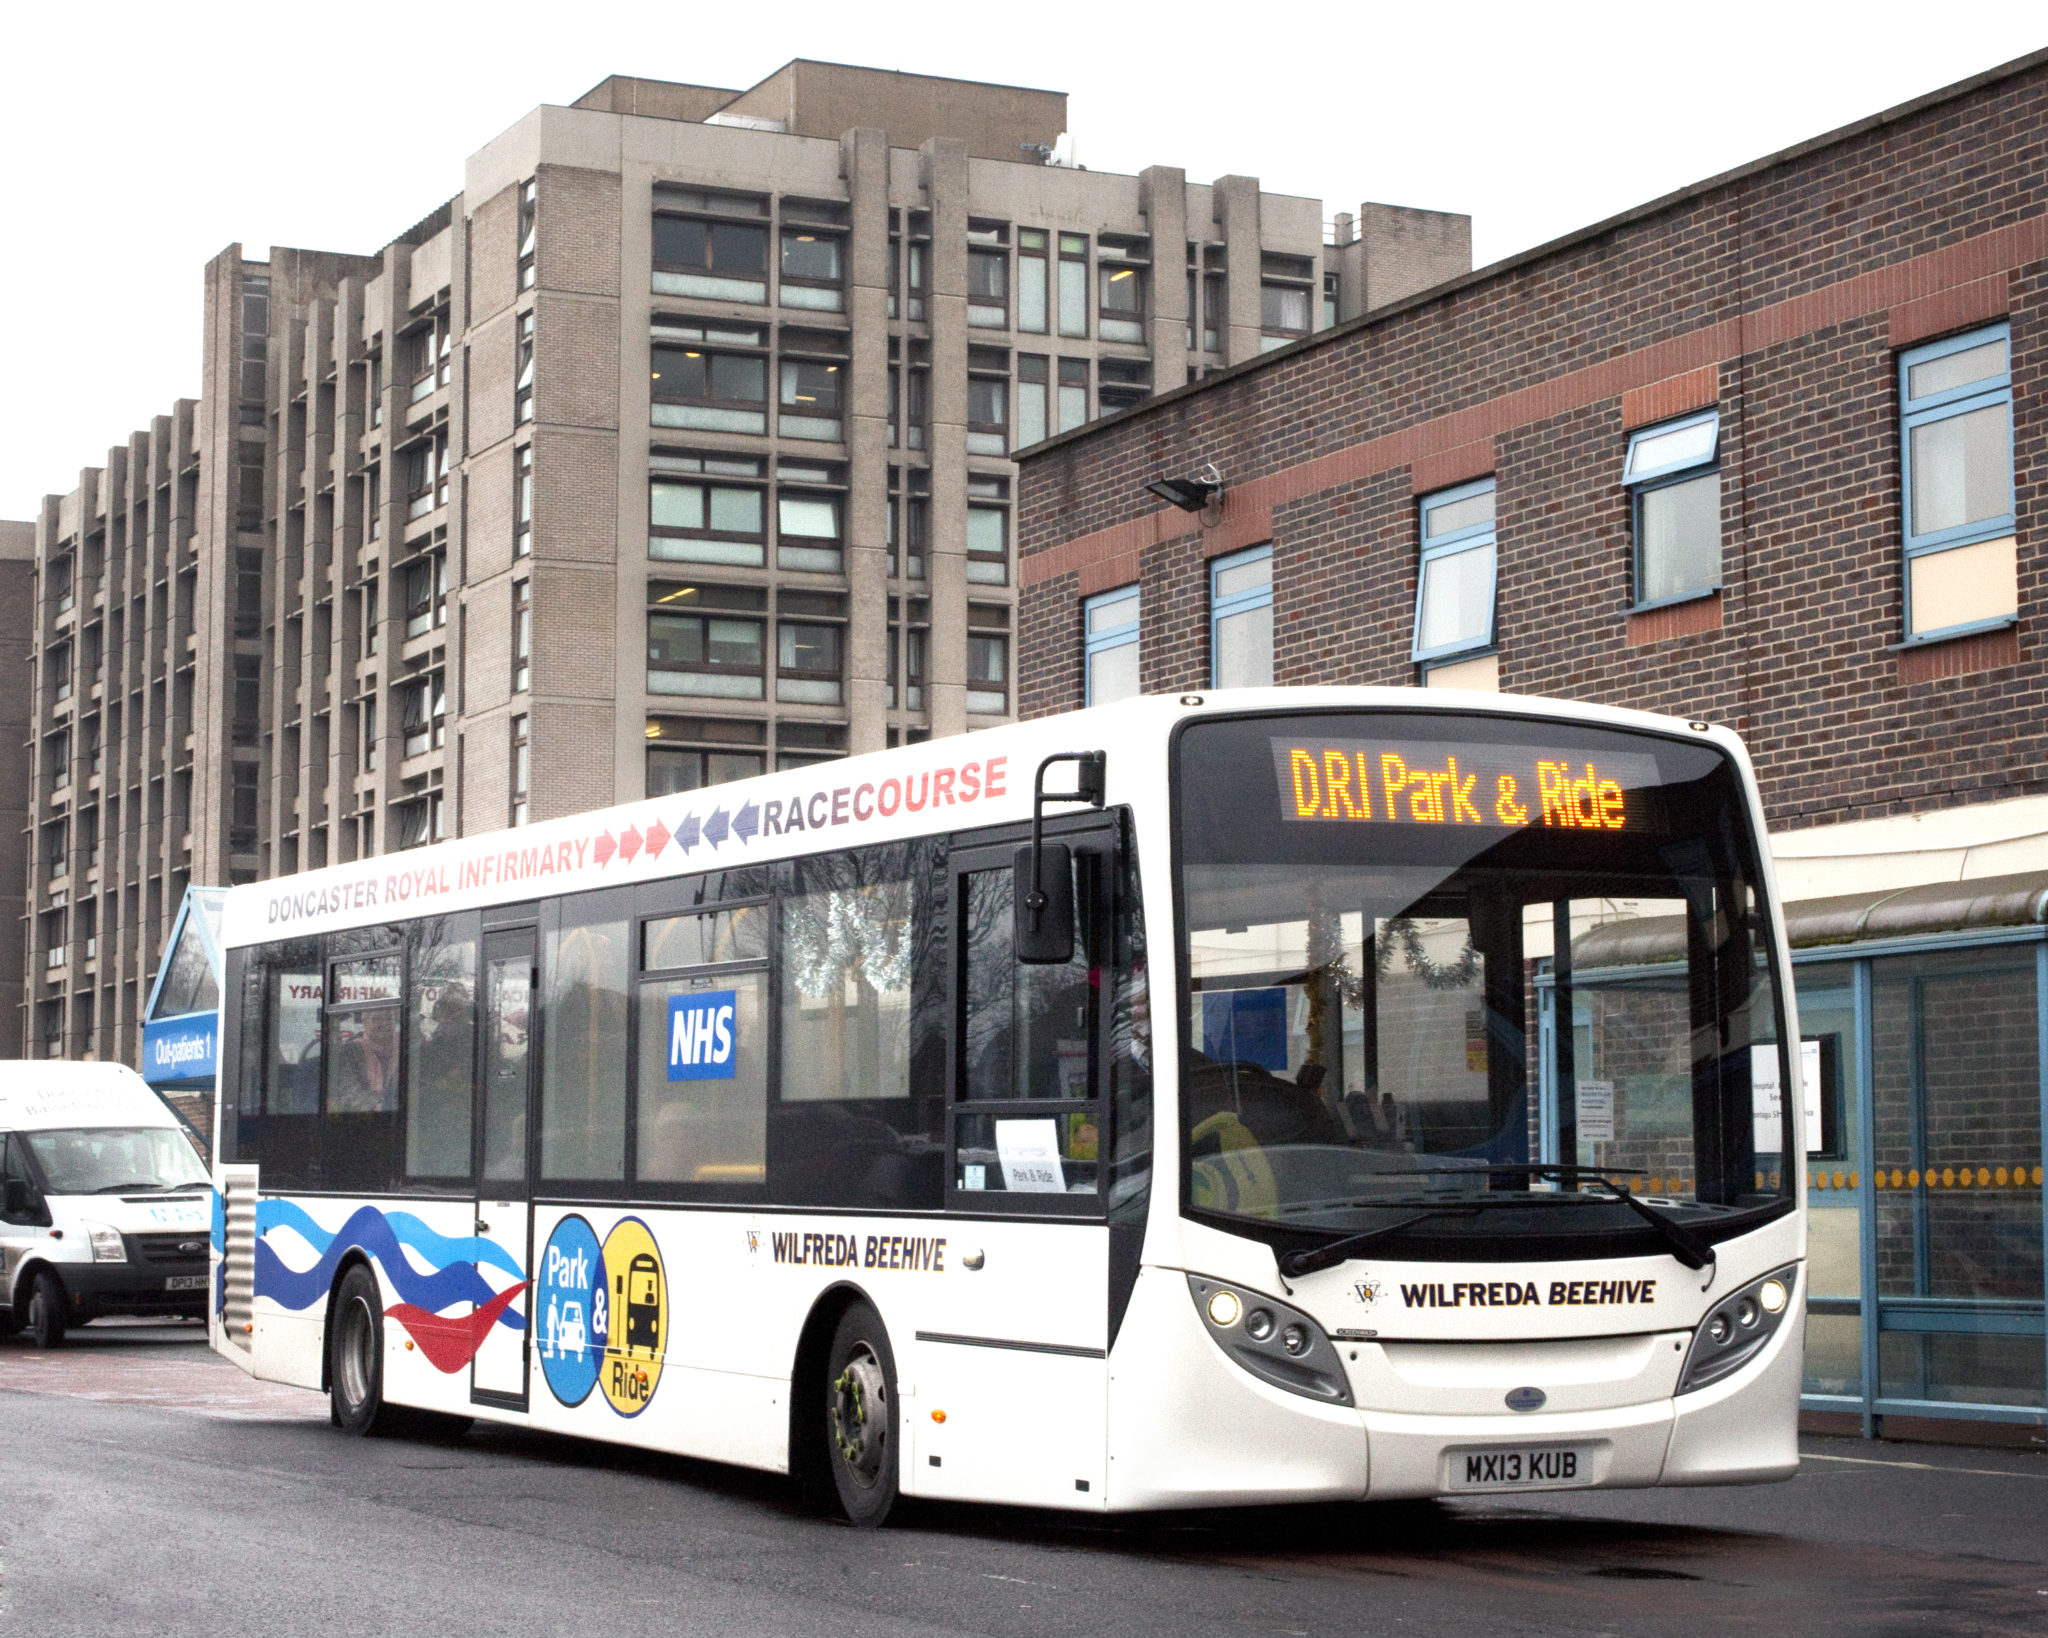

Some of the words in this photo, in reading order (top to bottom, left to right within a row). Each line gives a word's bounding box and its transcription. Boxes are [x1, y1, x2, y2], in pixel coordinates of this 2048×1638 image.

[1380, 753, 1482, 823] Park
[1495, 774, 1529, 825] &
[1536, 760, 1626, 829] Ride
[267, 878, 379, 925] DONCASTER
[385, 865, 451, 904] ROYAL
[457, 836, 590, 891] INFIRMARY
[762, 755, 1009, 837] RACECOURSE
[155, 1034, 205, 1070] Out-patients
[671, 1005, 733, 1066] NHS
[548, 1245, 588, 1290] Park
[771, 1231, 859, 1268] WILFREDA
[864, 1235, 947, 1272] BEEHIVE
[592, 1288, 607, 1334] &
[1400, 1282, 1541, 1309] WILFREDA
[1547, 1280, 1657, 1306] BEEHIVE
[612, 1361, 650, 1402] Ride
[1466, 1453, 1522, 1482] MX13
[1529, 1452, 1577, 1480] KUB
